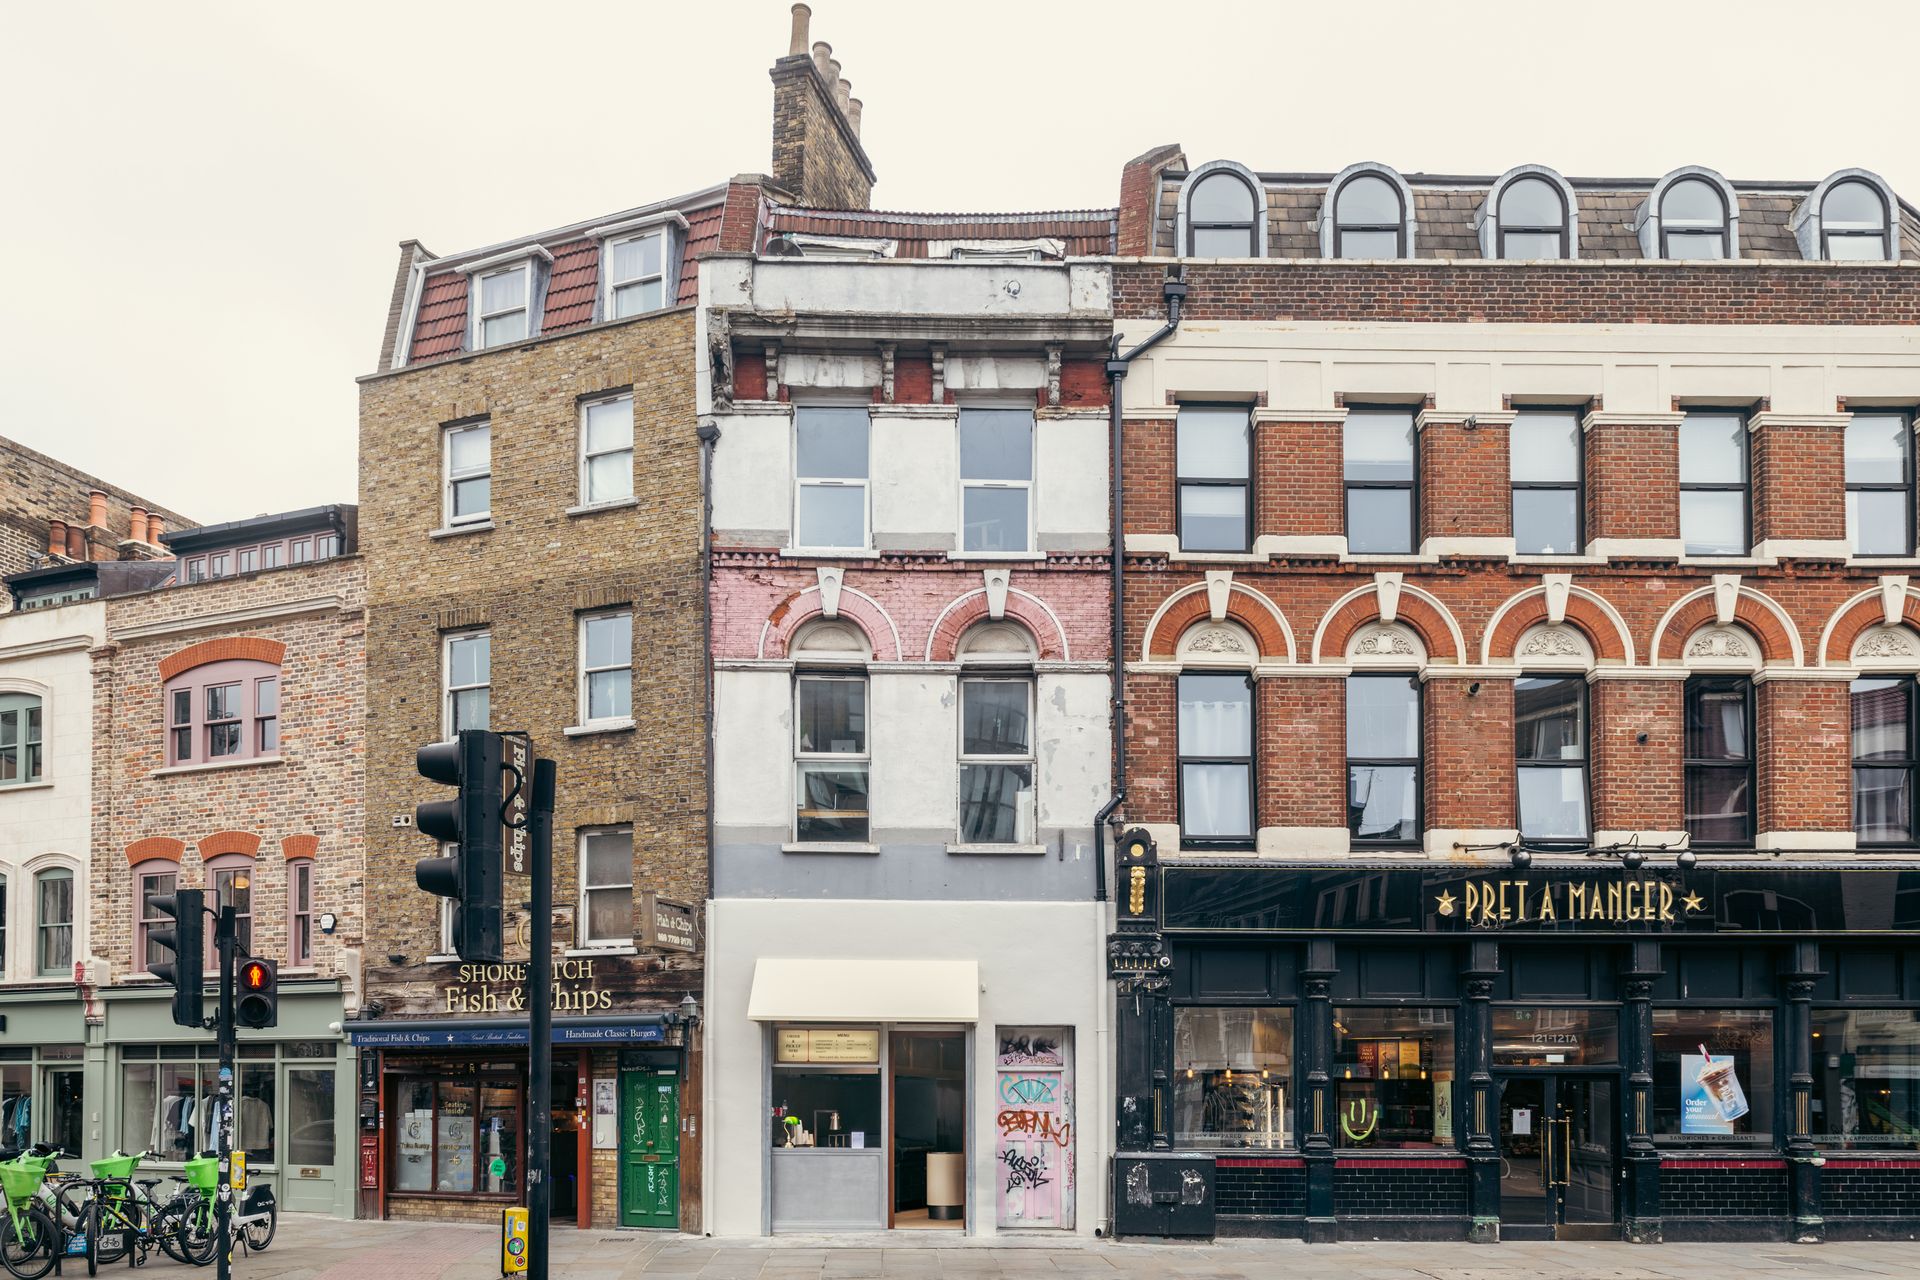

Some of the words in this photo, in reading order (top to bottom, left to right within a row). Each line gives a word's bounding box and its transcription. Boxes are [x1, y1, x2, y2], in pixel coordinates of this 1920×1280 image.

[513, 794, 526, 810] &
[1465, 880, 1529, 920] PRET
[1539, 880, 1556, 920] A
[1568, 880, 1676, 920] MANGER
[676, 916, 693, 935] Chips
[459, 960, 594, 983] SHORETCH
[444, 985, 498, 1013] Fish
[506, 986, 527, 1011] &
[548, 981, 612, 1016] hips
[357, 1035, 390, 1043] Traditional
[391, 1034, 404, 1042] Fish
[411, 1034, 430, 1043] Chips
[565, 1030, 603, 1039] Handmade
[604, 1029, 628, 1038] Classic
[630, 1028, 656, 1038] Burgers
[1531, 1033, 1578, 1043] 121-121A
[444, 1101, 467, 1109] Seating
[1685, 1098, 1708, 1106] Order
[1685, 1106, 1703, 1114] your
